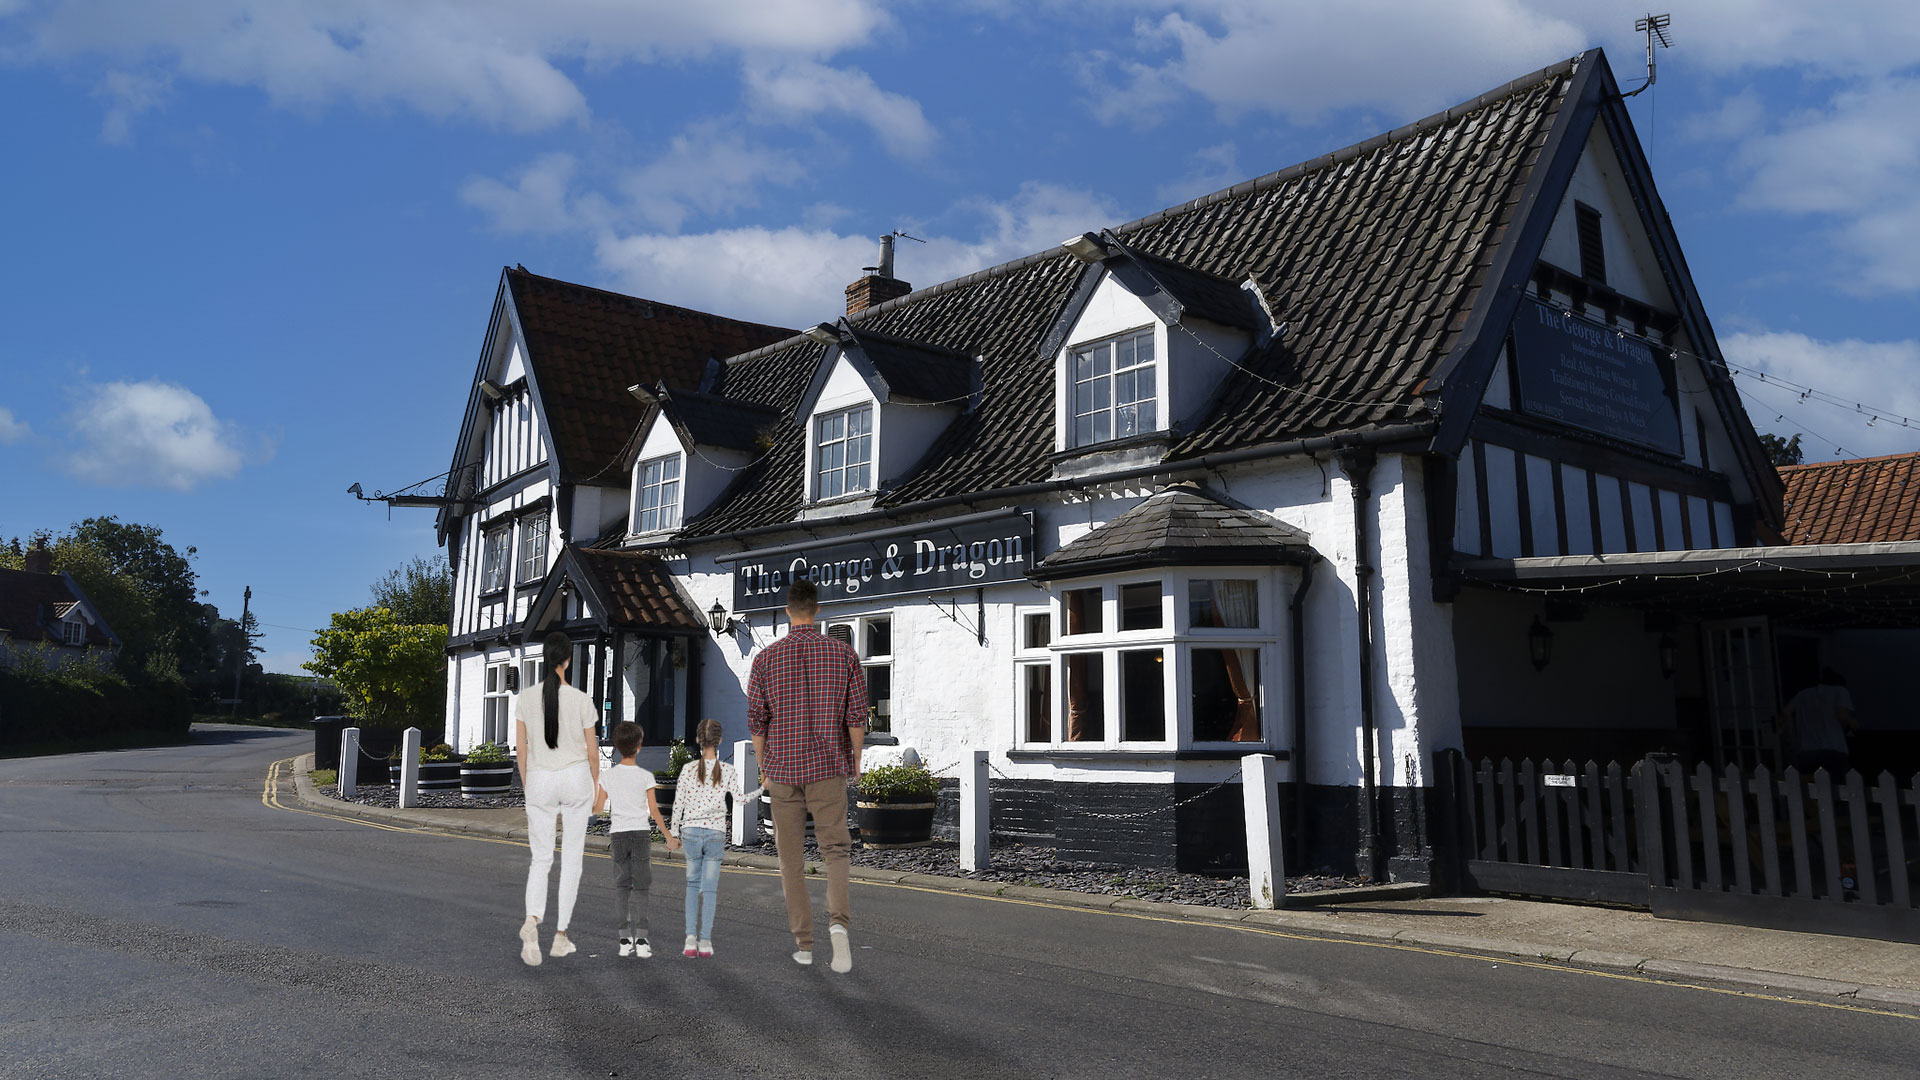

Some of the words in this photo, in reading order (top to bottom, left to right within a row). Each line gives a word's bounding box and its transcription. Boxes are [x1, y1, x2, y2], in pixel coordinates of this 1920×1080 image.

[1536, 303, 1560, 329] The
[1562, 314, 1601, 347] George
[1604, 330, 1614, 349] &
[1616, 334, 1653, 364] Dragon
[1560, 353, 1577, 370] Real
[1560, 390, 1584, 409] Served
[741, 564, 781, 596] The
[788, 557, 873, 593] George
[881, 543, 905, 580] &
[913, 535, 1024, 579] Dragon
